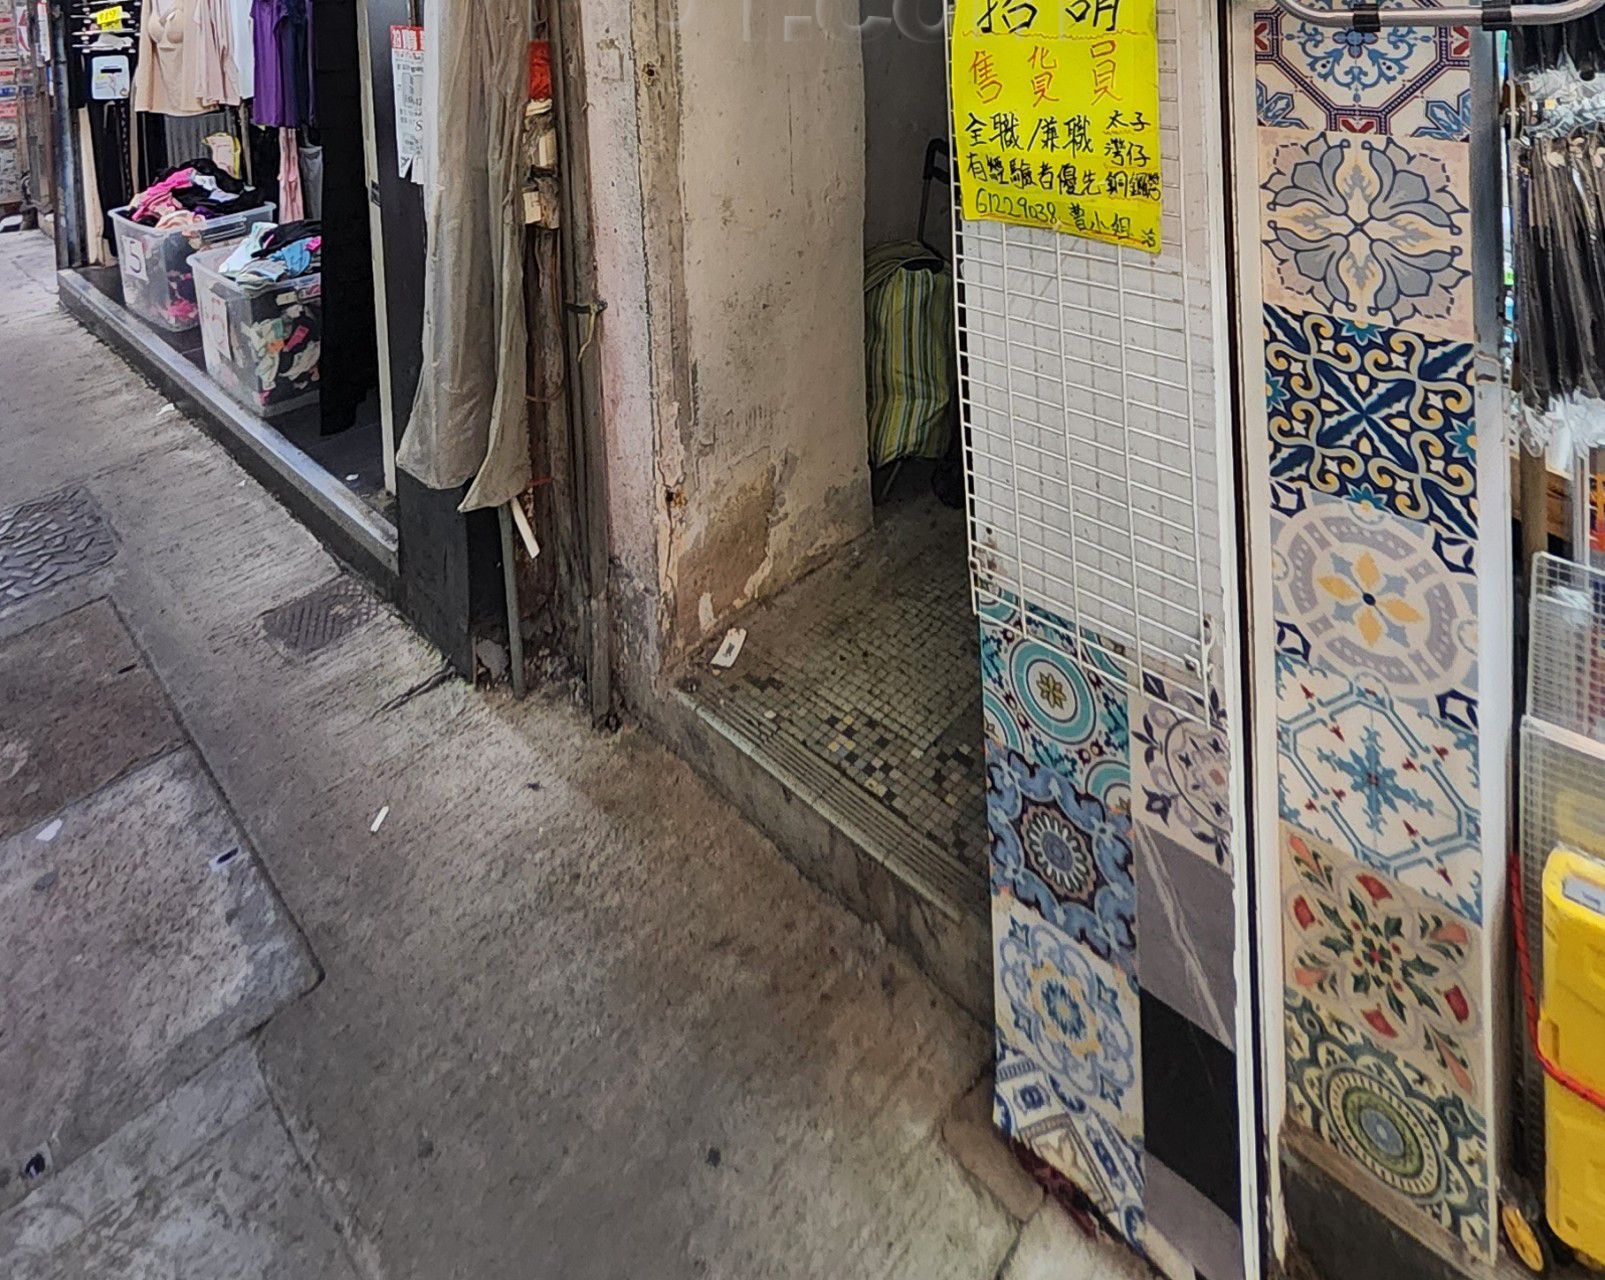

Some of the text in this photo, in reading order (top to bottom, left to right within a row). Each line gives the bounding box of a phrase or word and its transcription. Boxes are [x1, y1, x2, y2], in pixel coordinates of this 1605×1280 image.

[969, 39, 1124, 108] 售貨員
[1105, 109, 1151, 132] 太子
[1103, 137, 1151, 167] 灣仔
